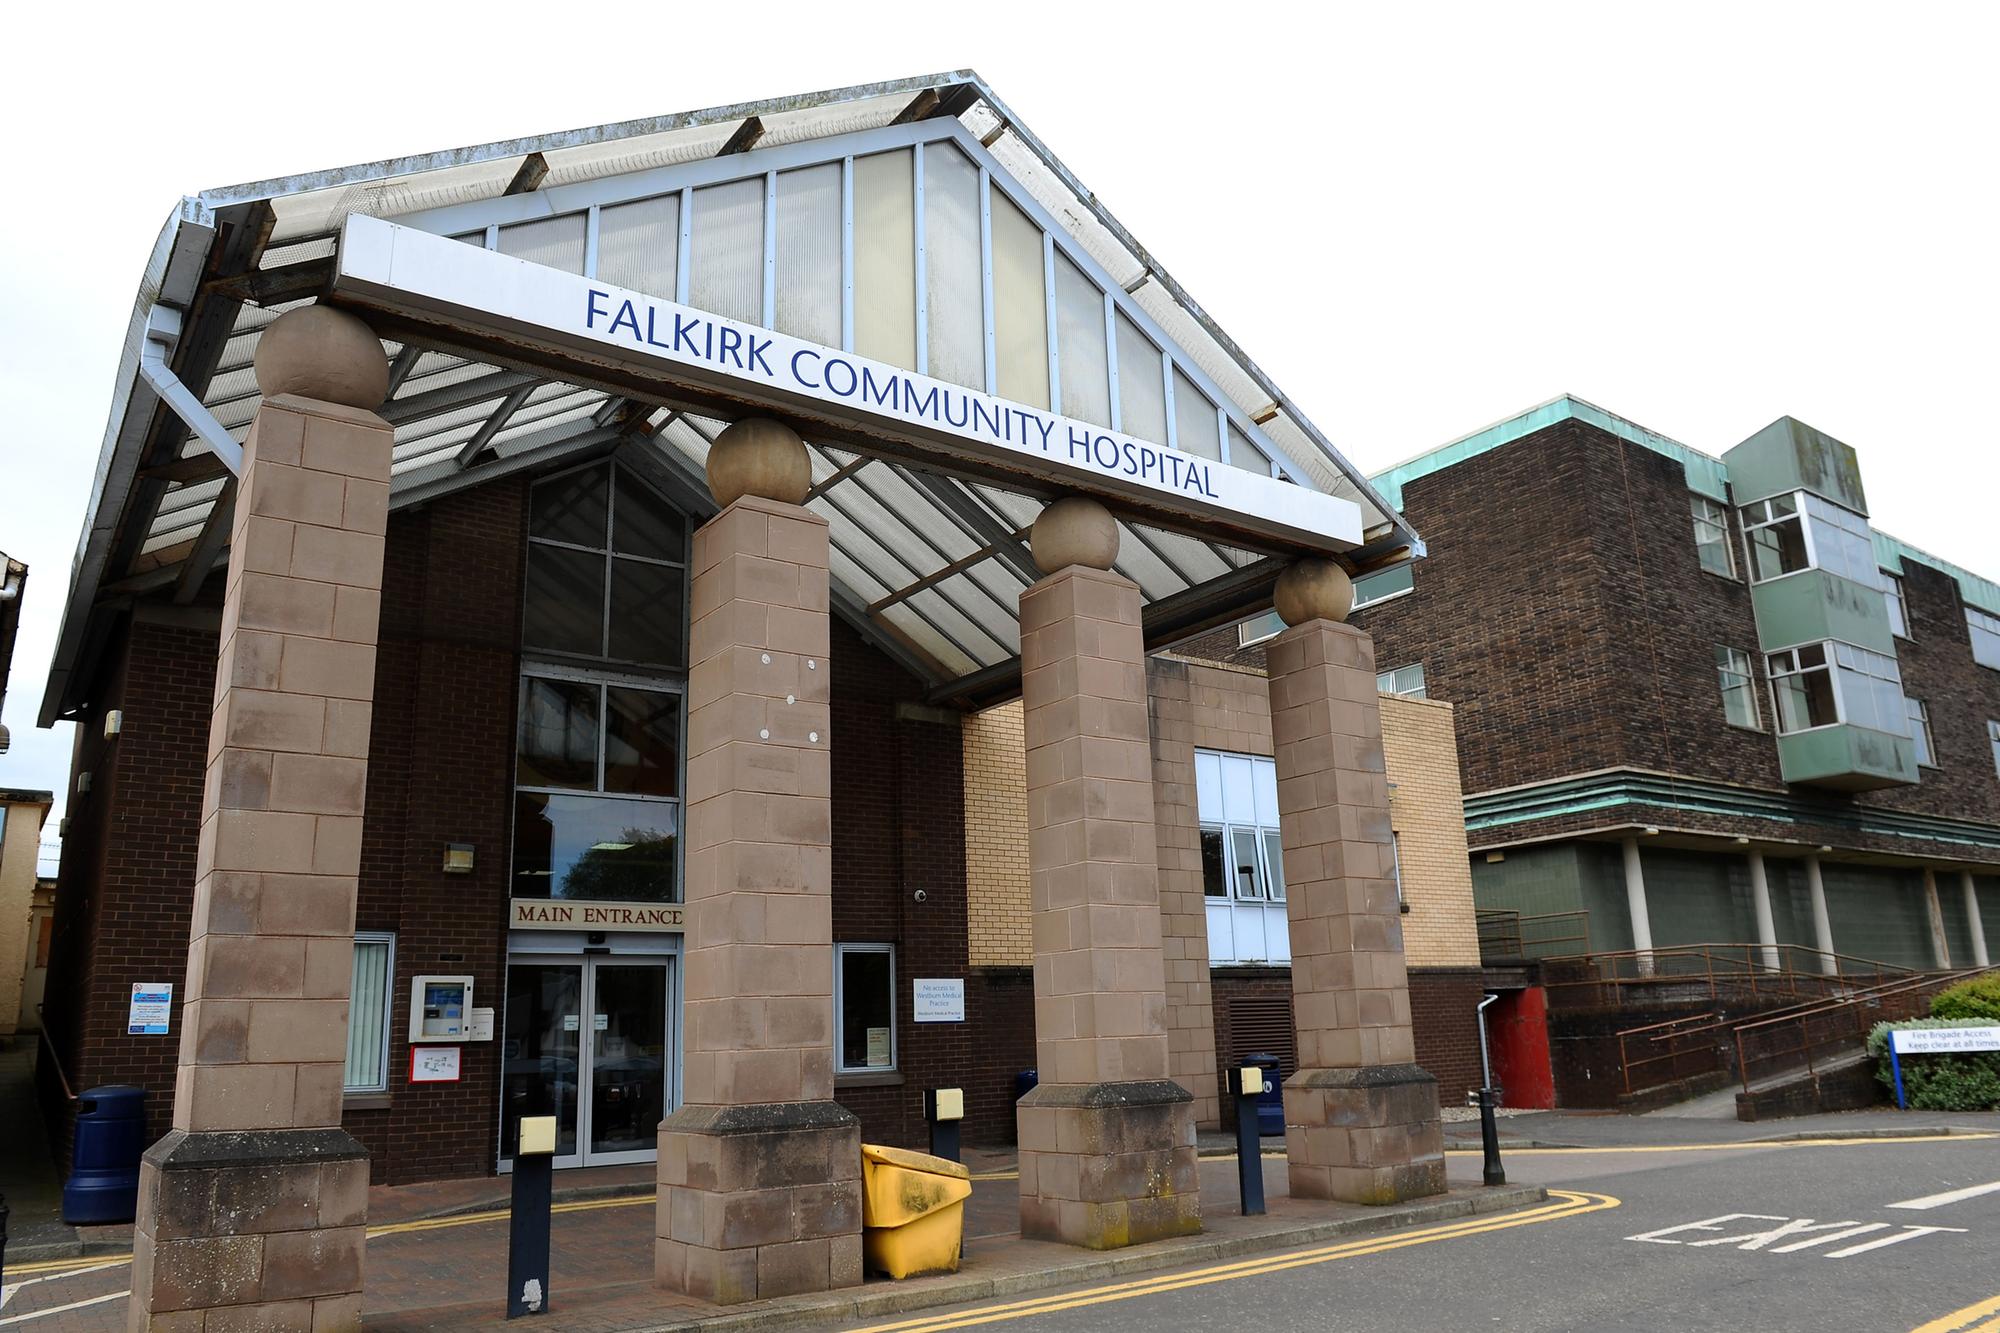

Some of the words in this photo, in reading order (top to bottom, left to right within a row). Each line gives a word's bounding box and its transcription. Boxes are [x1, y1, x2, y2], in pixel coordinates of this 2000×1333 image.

[585, 289, 774, 377] FALKIRK
[790, 348, 1056, 452] COMMUNITY
[1067, 425, 1220, 499] HOSPITAL
[517, 905, 573, 922] MAIN
[583, 907, 683, 925] ENTRANCE
[1912, 1031, 1927, 1039] Fire
[1929, 1031, 1961, 1040] Brigade
[1963, 1030, 1992, 1038] Access
[1908, 1043, 1930, 1051] Keep
[1624, 1213, 1968, 1258] EXIT
